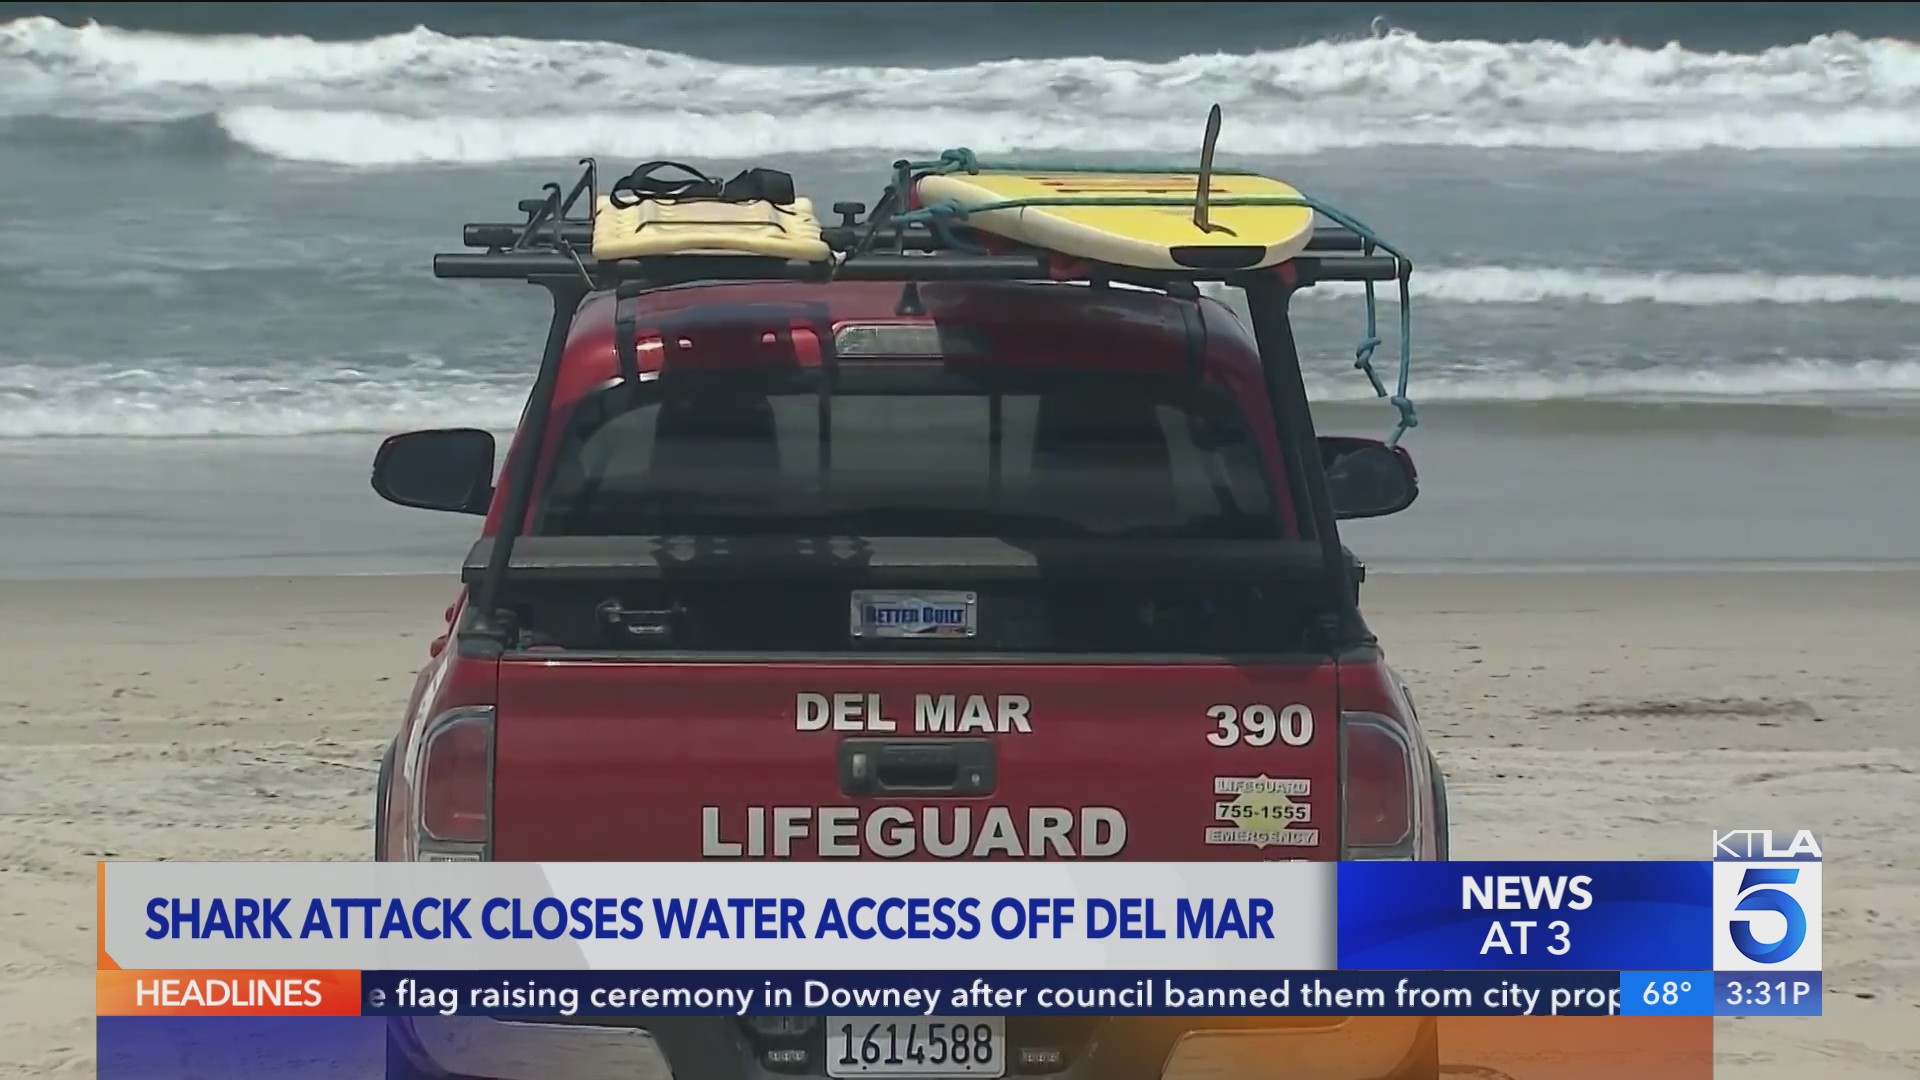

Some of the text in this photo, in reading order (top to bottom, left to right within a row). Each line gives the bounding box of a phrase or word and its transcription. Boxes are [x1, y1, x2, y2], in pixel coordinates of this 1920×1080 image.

[865, 606, 964, 624] BETTER BUILT
[795, 693, 1033, 733] DEL MAR
[1205, 704, 1314, 747] 390
[701, 806, 1128, 858] LIFEGUARD
[1219, 805, 1306, 819] 755-1555
[1210, 830, 1315, 843] EMERGENCY
[839, 1023, 993, 1065] 1614588
